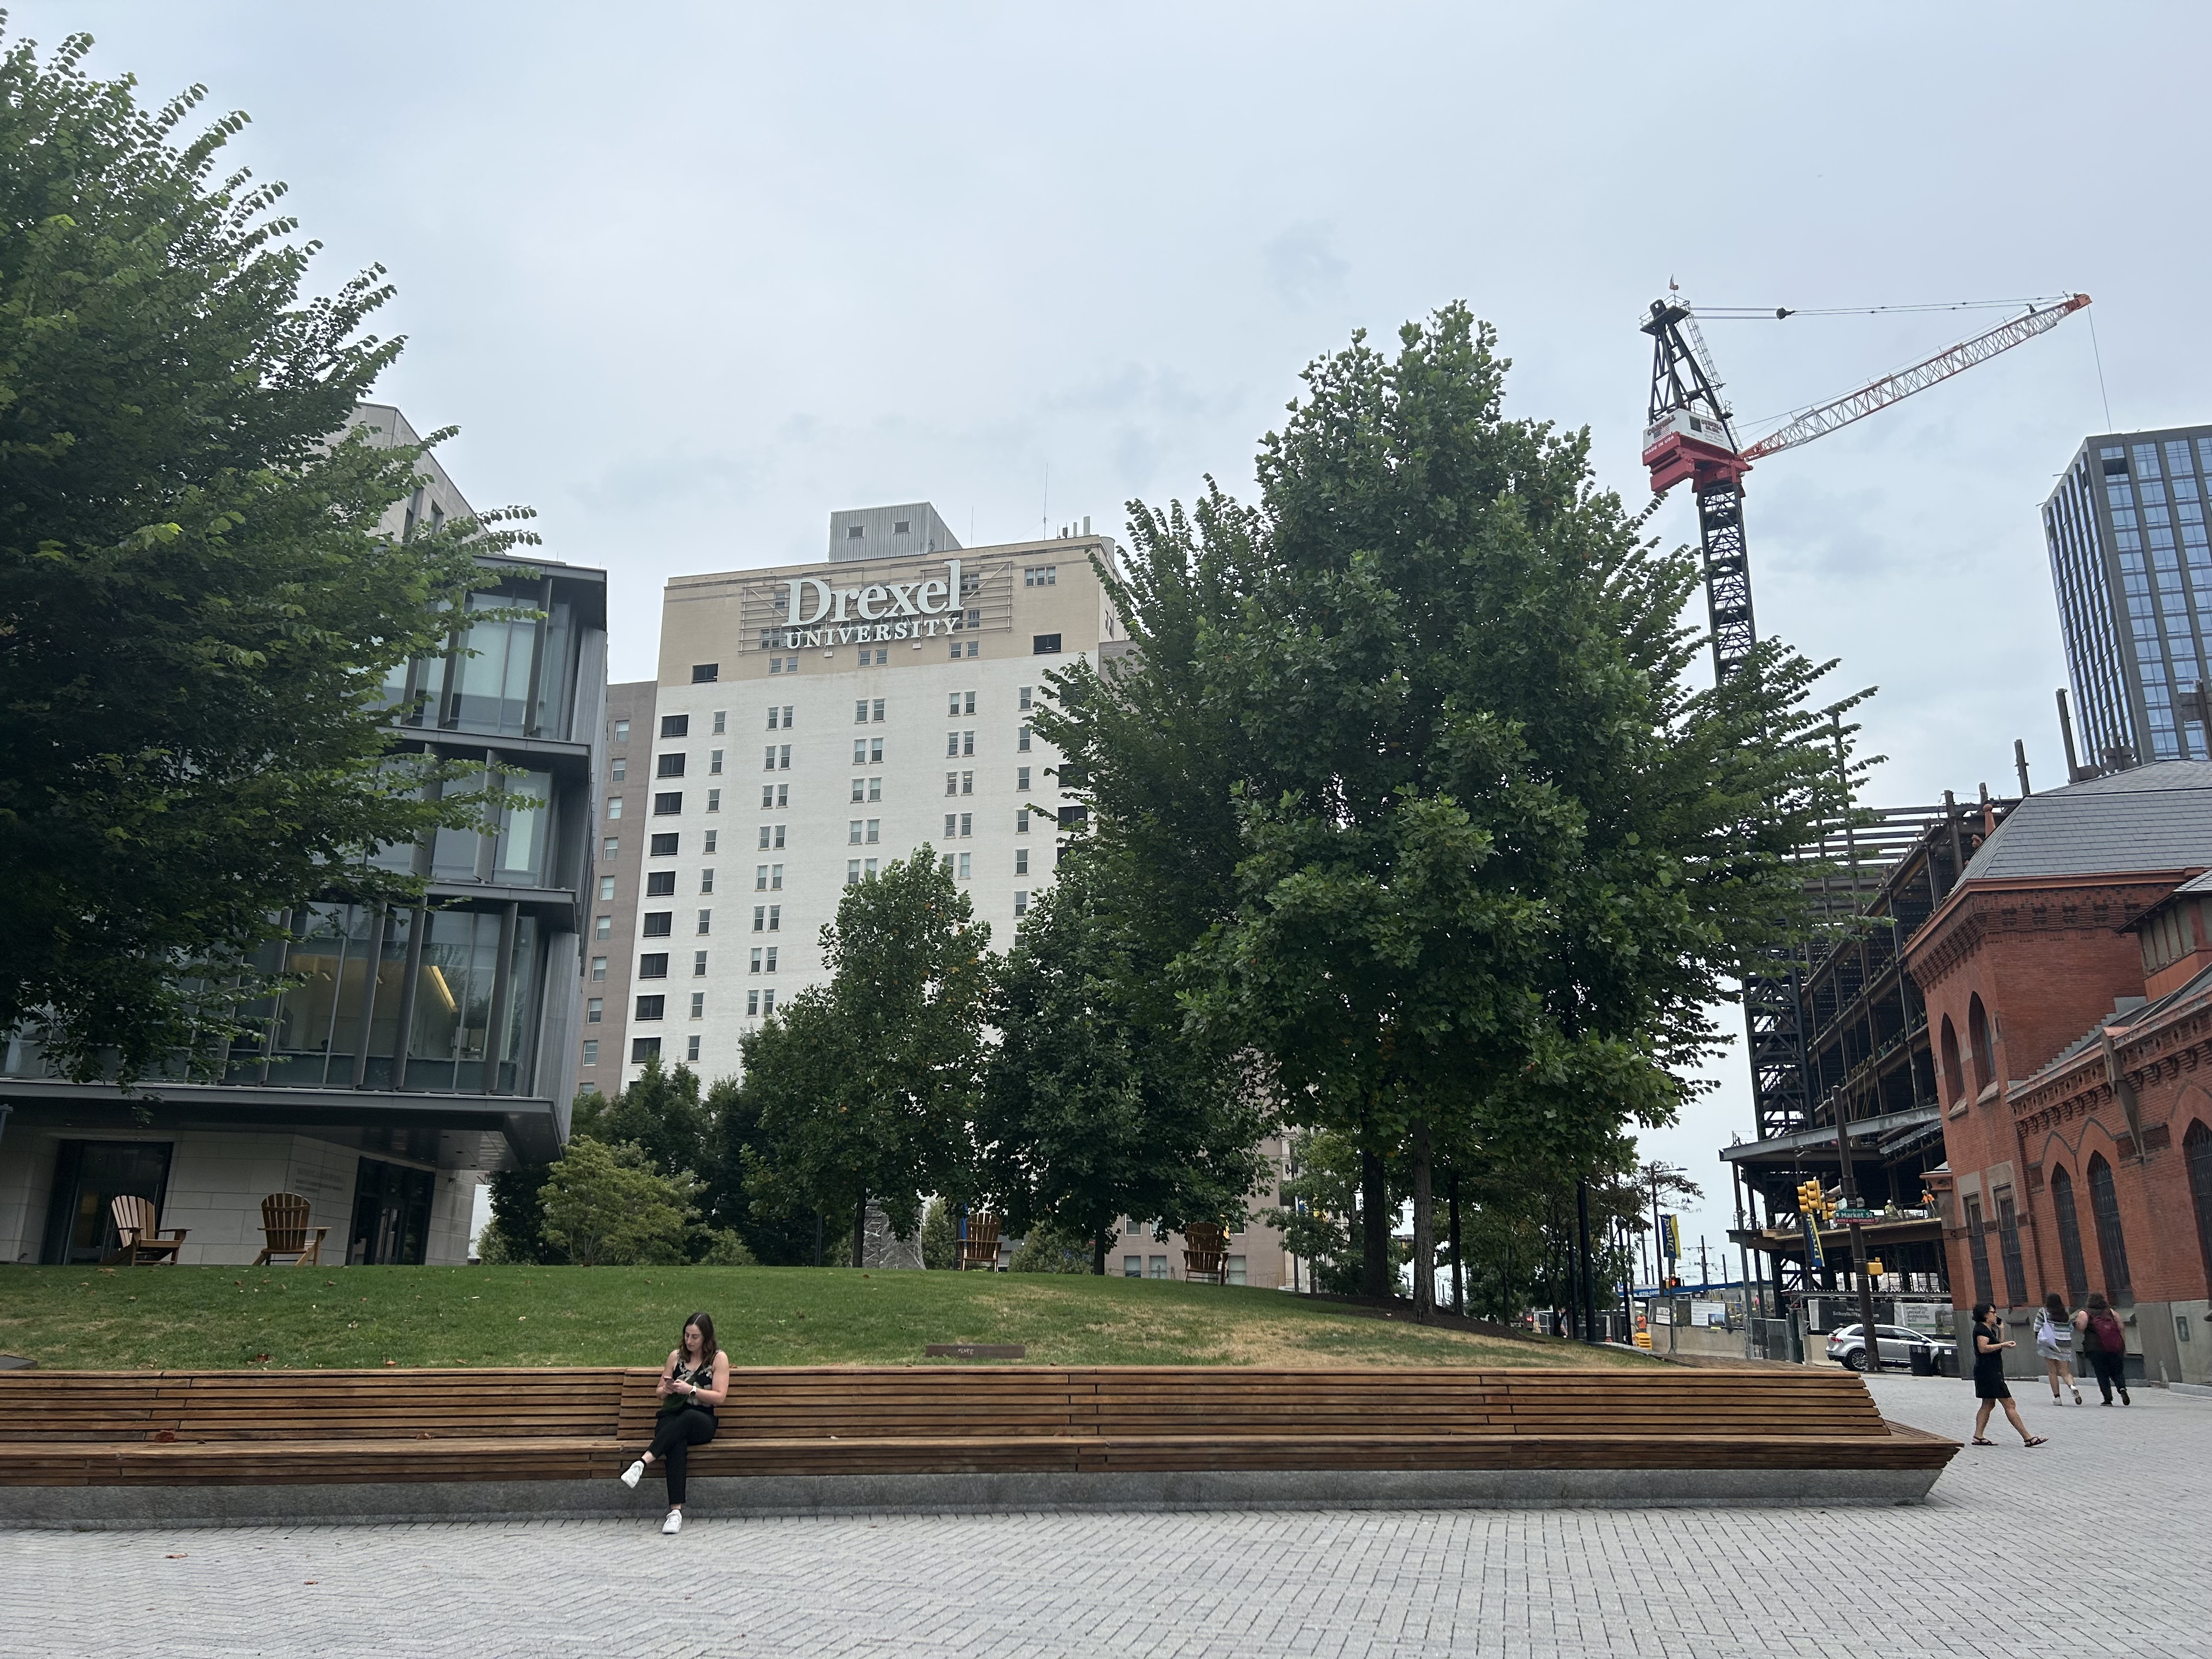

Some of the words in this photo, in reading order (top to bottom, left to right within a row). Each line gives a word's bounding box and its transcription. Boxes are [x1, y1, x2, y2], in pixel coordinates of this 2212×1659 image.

[1644, 445, 1657, 456] MADE
[1664, 435, 1674, 443] USA
[782, 559, 964, 627] Drexel
[785, 617, 960, 649] UNIVERSITY
